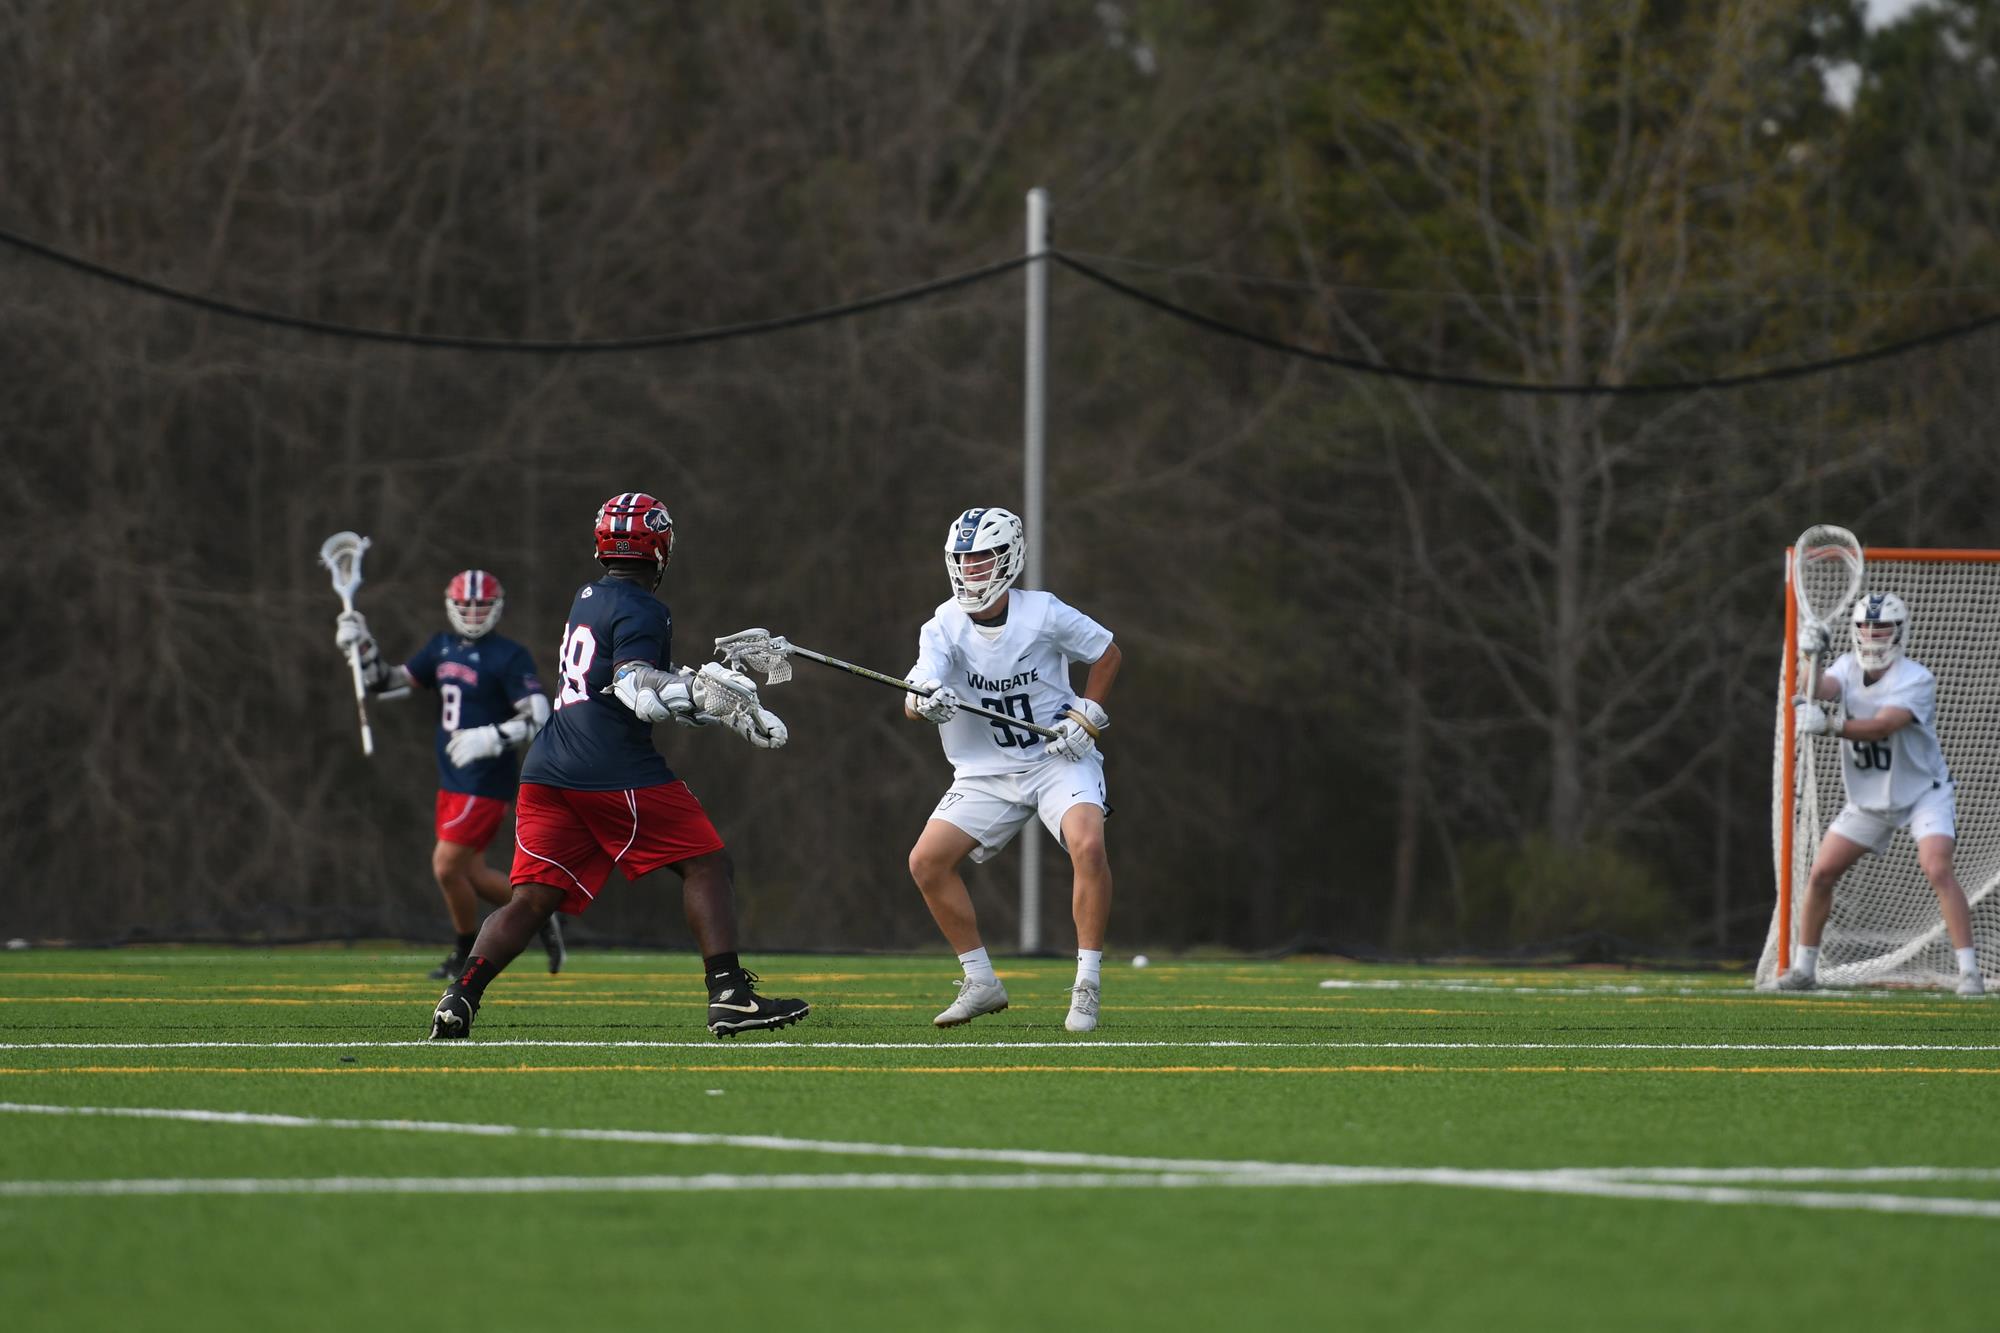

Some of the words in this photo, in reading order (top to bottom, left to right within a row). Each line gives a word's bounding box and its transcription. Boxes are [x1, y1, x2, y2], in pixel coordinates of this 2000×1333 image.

[554, 621, 597, 709] 8
[966, 667, 1039, 693] WINGATE
[441, 683, 462, 732] 8
